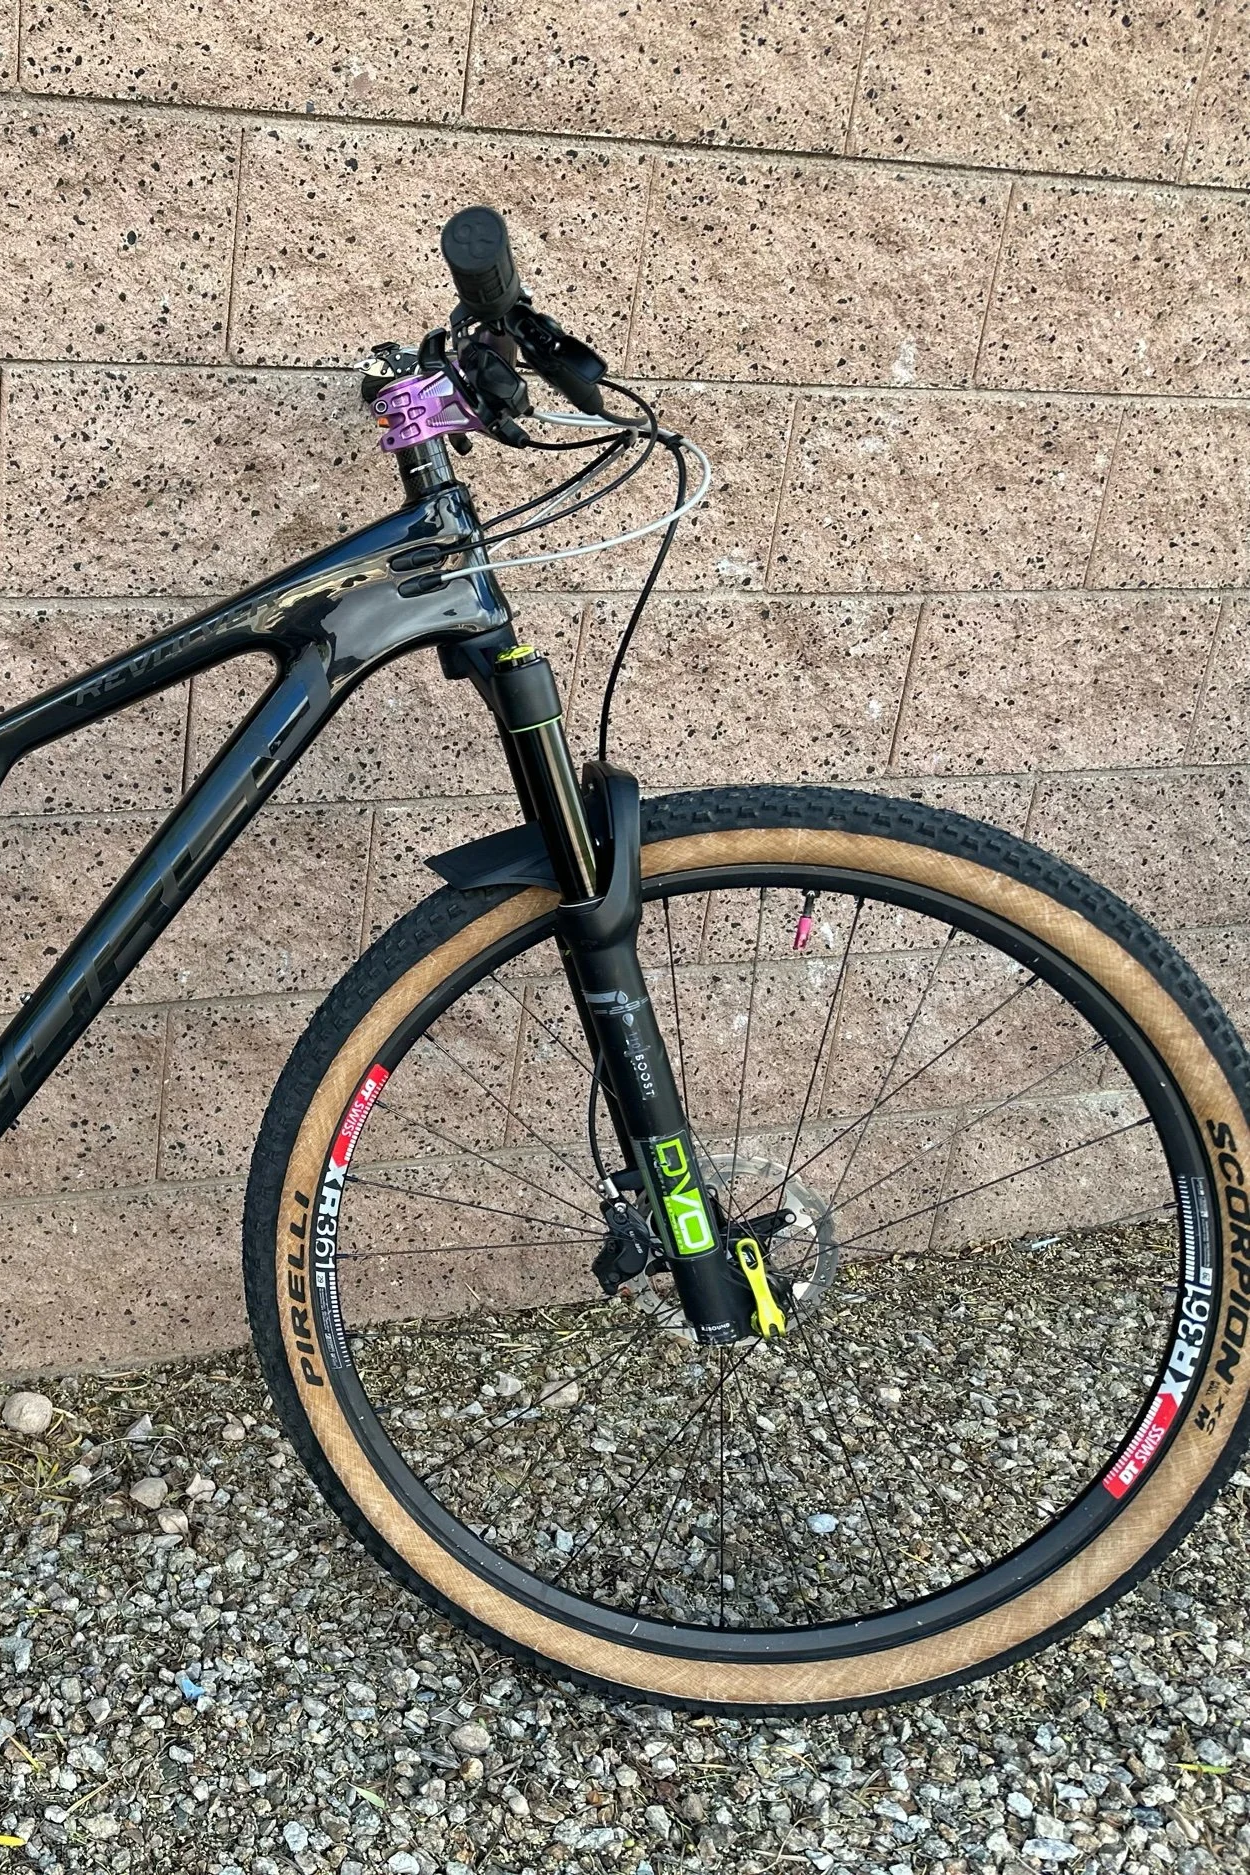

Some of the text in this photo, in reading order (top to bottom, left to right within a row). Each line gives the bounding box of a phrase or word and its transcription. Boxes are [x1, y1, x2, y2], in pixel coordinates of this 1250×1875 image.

[340, 1101, 366, 1138] SWISS
[361, 1078, 376, 1101] DT
[315, 1161, 348, 1270] XR361
[655, 1138, 711, 1250] DVO
[287, 1190, 324, 1388] PIRELLI
[1206, 1118, 1250, 1387] SCORPION
[1120, 1462, 1139, 1486] DT
[1133, 1424, 1164, 1463] SWISS
[1158, 1285, 1212, 1407] XR361
